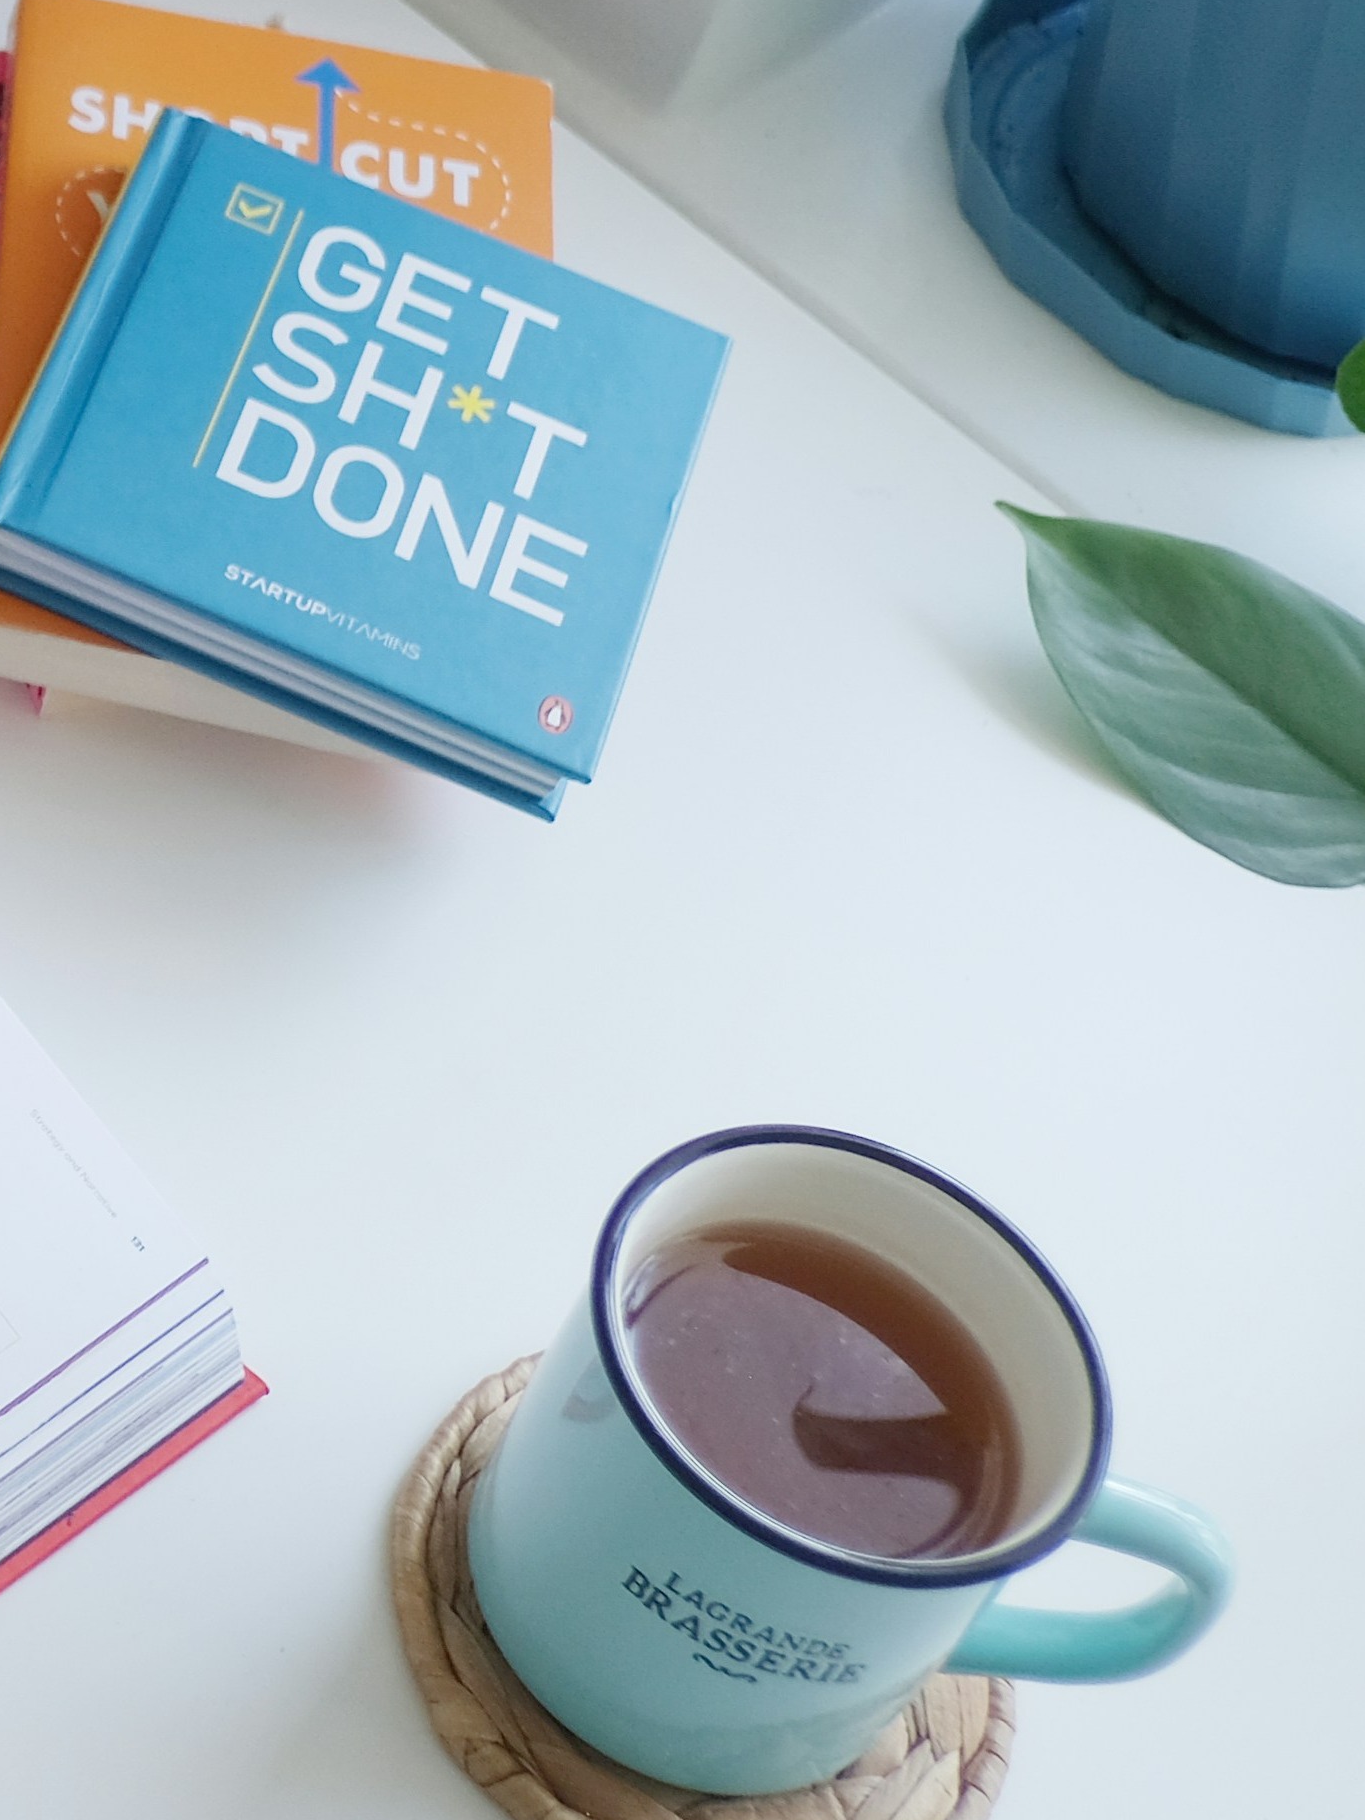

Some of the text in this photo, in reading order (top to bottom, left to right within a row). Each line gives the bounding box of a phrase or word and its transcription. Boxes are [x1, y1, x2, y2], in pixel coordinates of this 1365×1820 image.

[339, 142, 482, 208] CUT
[296, 224, 560, 382] GET
[214, 397, 589, 628] DONE
[224, 562, 422, 662] STARTUPVITAMINS
[620, 1565, 868, 1684] BRASSERIE
[664, 1570, 852, 1660] LAGRANDE
